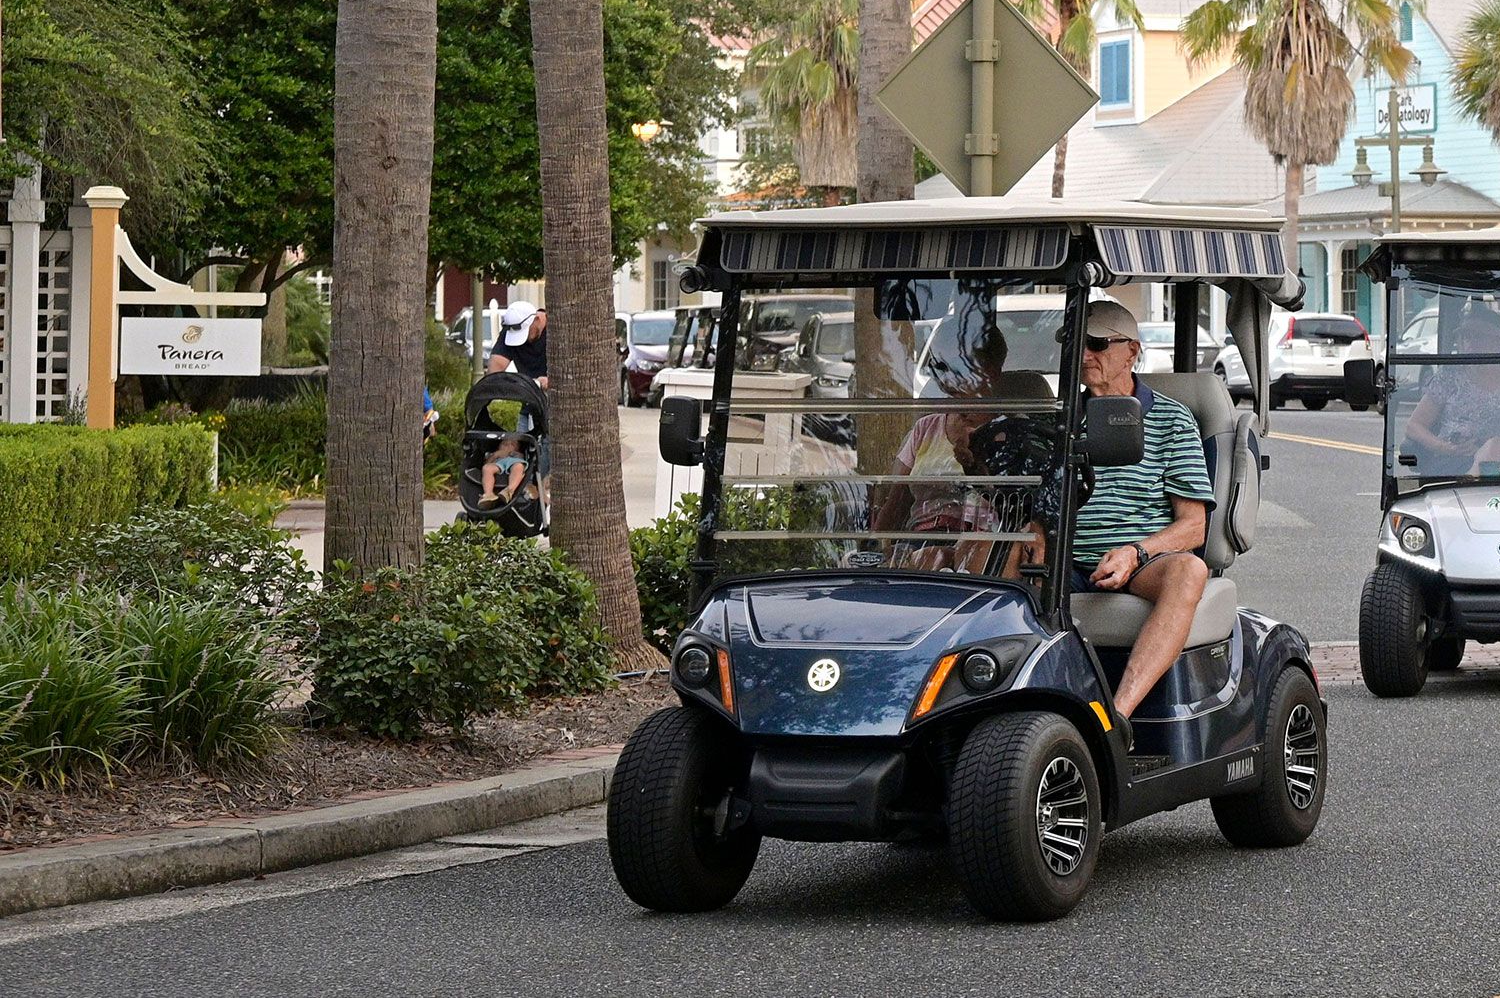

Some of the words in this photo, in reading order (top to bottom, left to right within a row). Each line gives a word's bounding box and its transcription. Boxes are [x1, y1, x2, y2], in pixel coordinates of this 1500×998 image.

[1378, 106, 1431, 124] Deatology
[157, 344, 224, 361] Panera
[1227, 756, 1254, 782] YAMAHA
